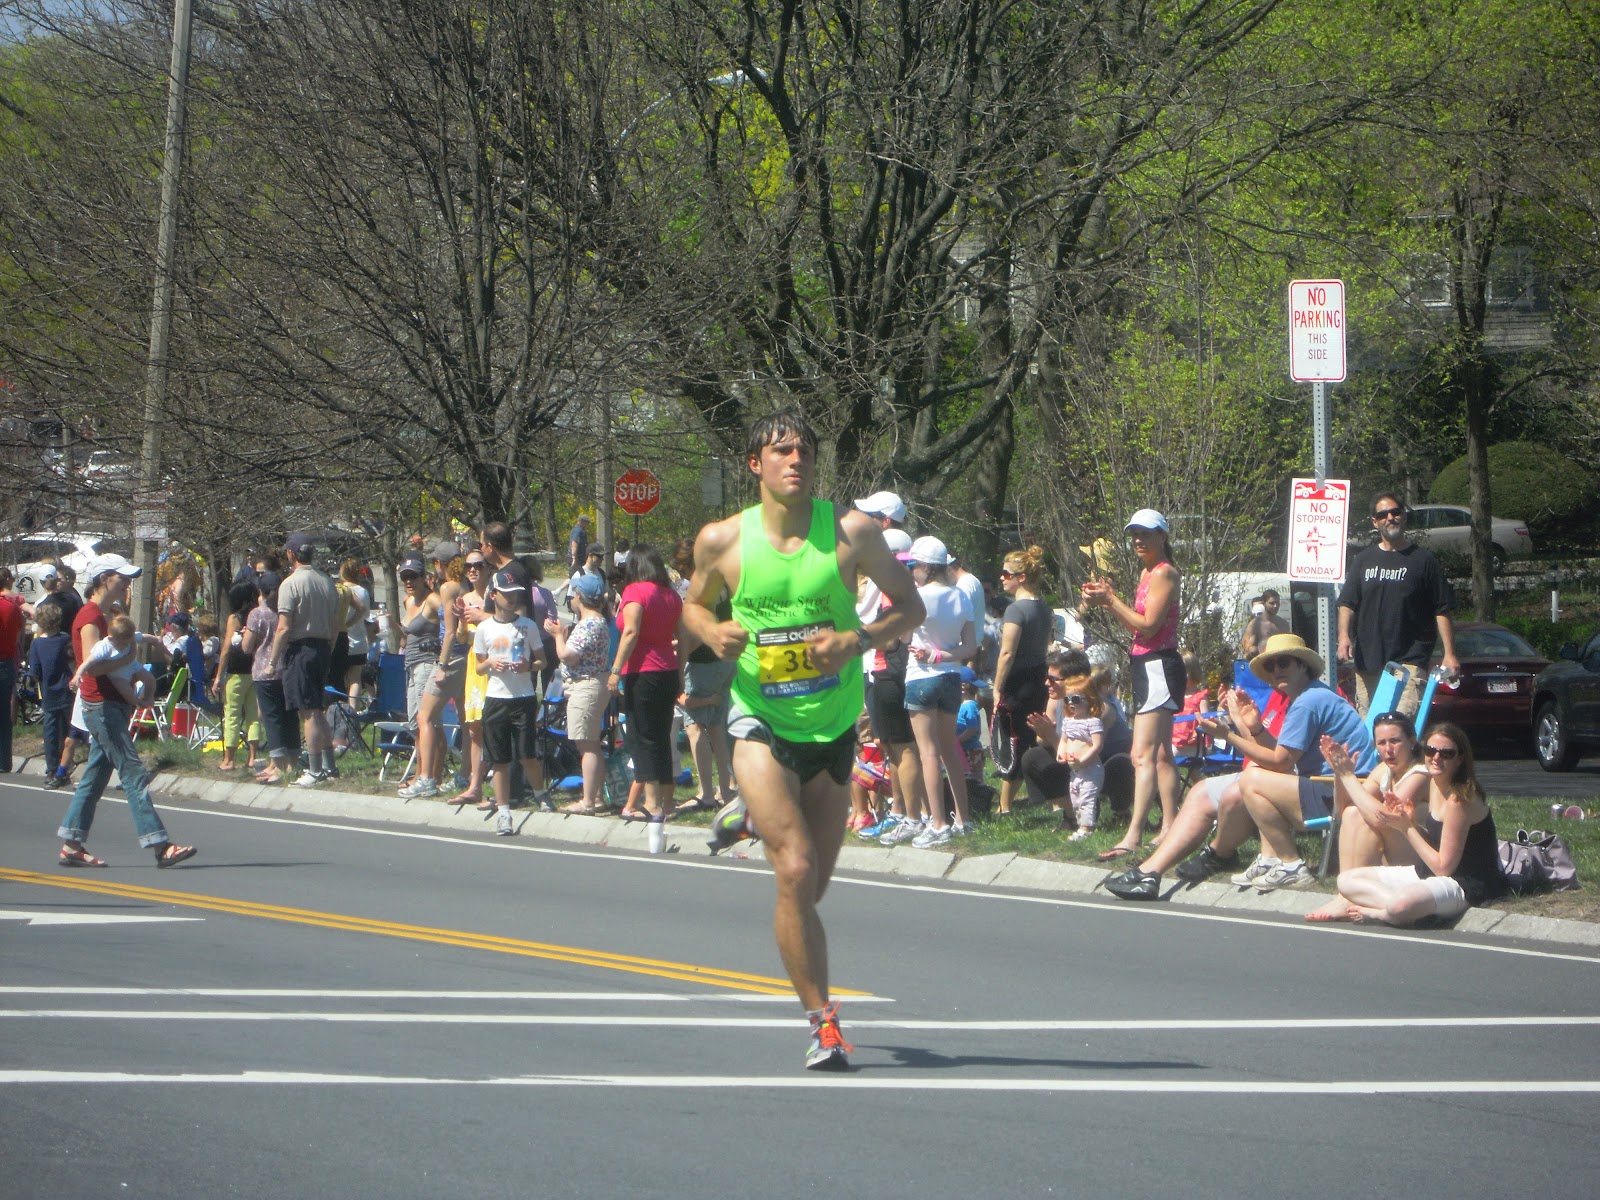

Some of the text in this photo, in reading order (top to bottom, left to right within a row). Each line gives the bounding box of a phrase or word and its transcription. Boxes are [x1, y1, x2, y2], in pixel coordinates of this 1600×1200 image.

[1308, 288, 1326, 306] NO
[1294, 310, 1341, 328] PARKING
[1308, 333, 1328, 344] THIS
[1308, 348, 1328, 360] SIDE
[618, 482, 658, 500] STOP
[1310, 502, 1328, 514] NO
[1296, 514, 1341, 525] STOPPING
[1296, 566, 1336, 576] MONDAY
[1365, 565, 1379, 581] got
